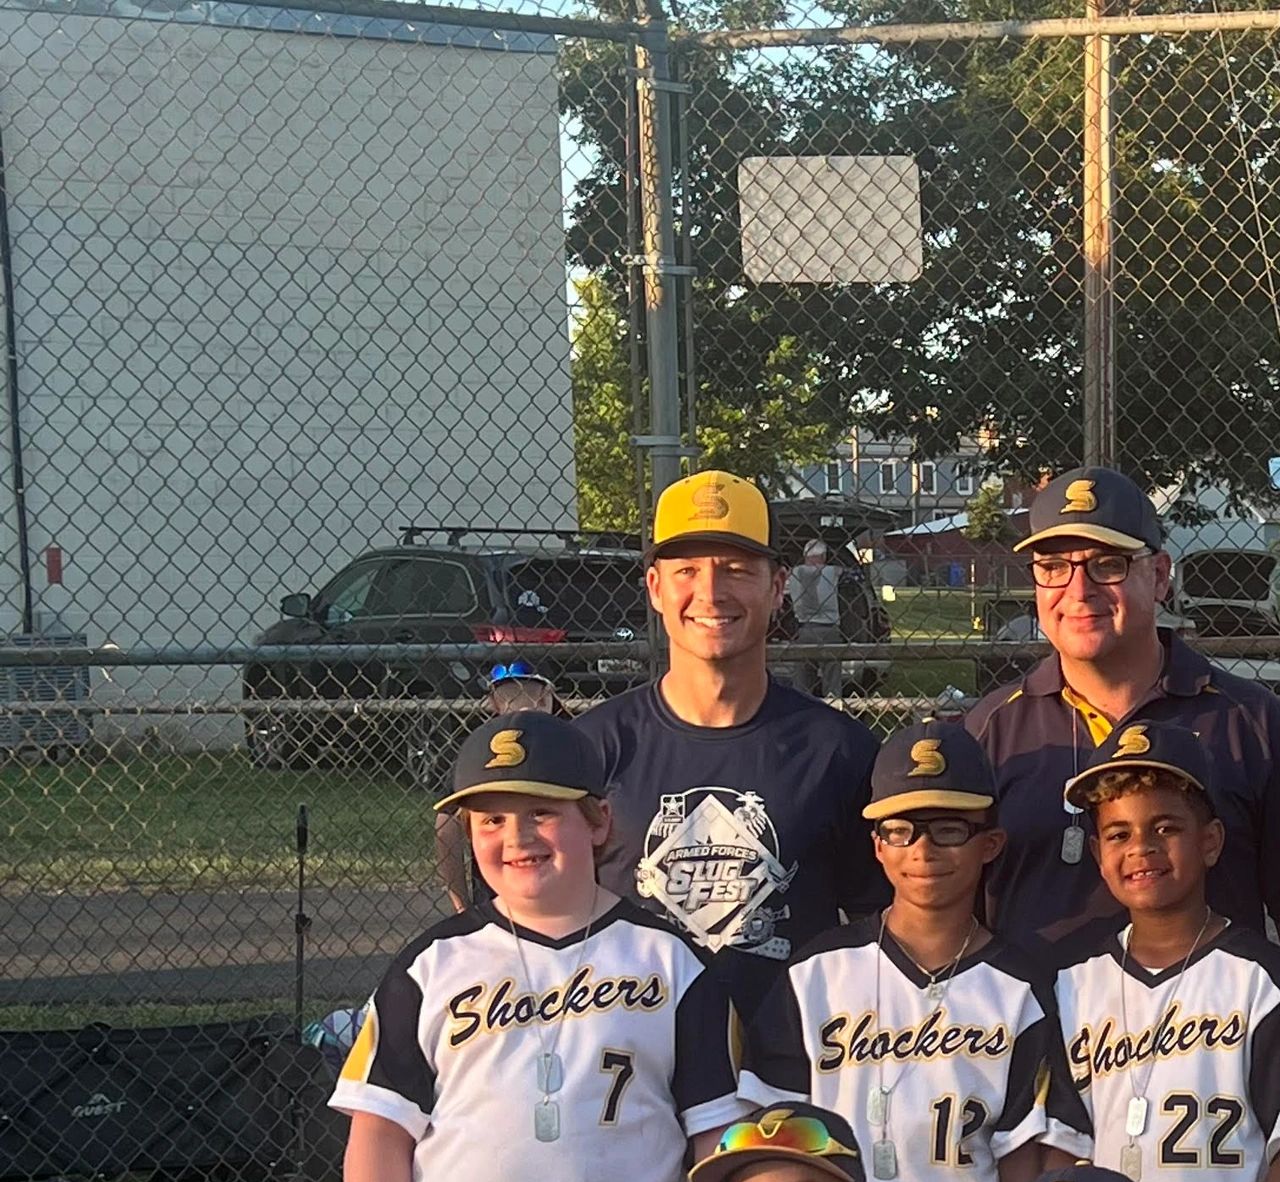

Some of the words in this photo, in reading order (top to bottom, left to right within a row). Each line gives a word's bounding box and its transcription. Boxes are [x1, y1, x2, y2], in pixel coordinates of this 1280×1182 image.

[666, 860, 742, 894] SLUG
[710, 846, 757, 861] FORCES
[684, 880, 758, 911] FEST
[448, 965, 668, 1047] Shockers
[817, 1010, 1012, 1075] Shockers
[1068, 1001, 1248, 1091] Shockers
[600, 1047, 637, 1126] 7
[931, 1094, 990, 1168] 12
[1159, 1091, 1244, 1168] 22
